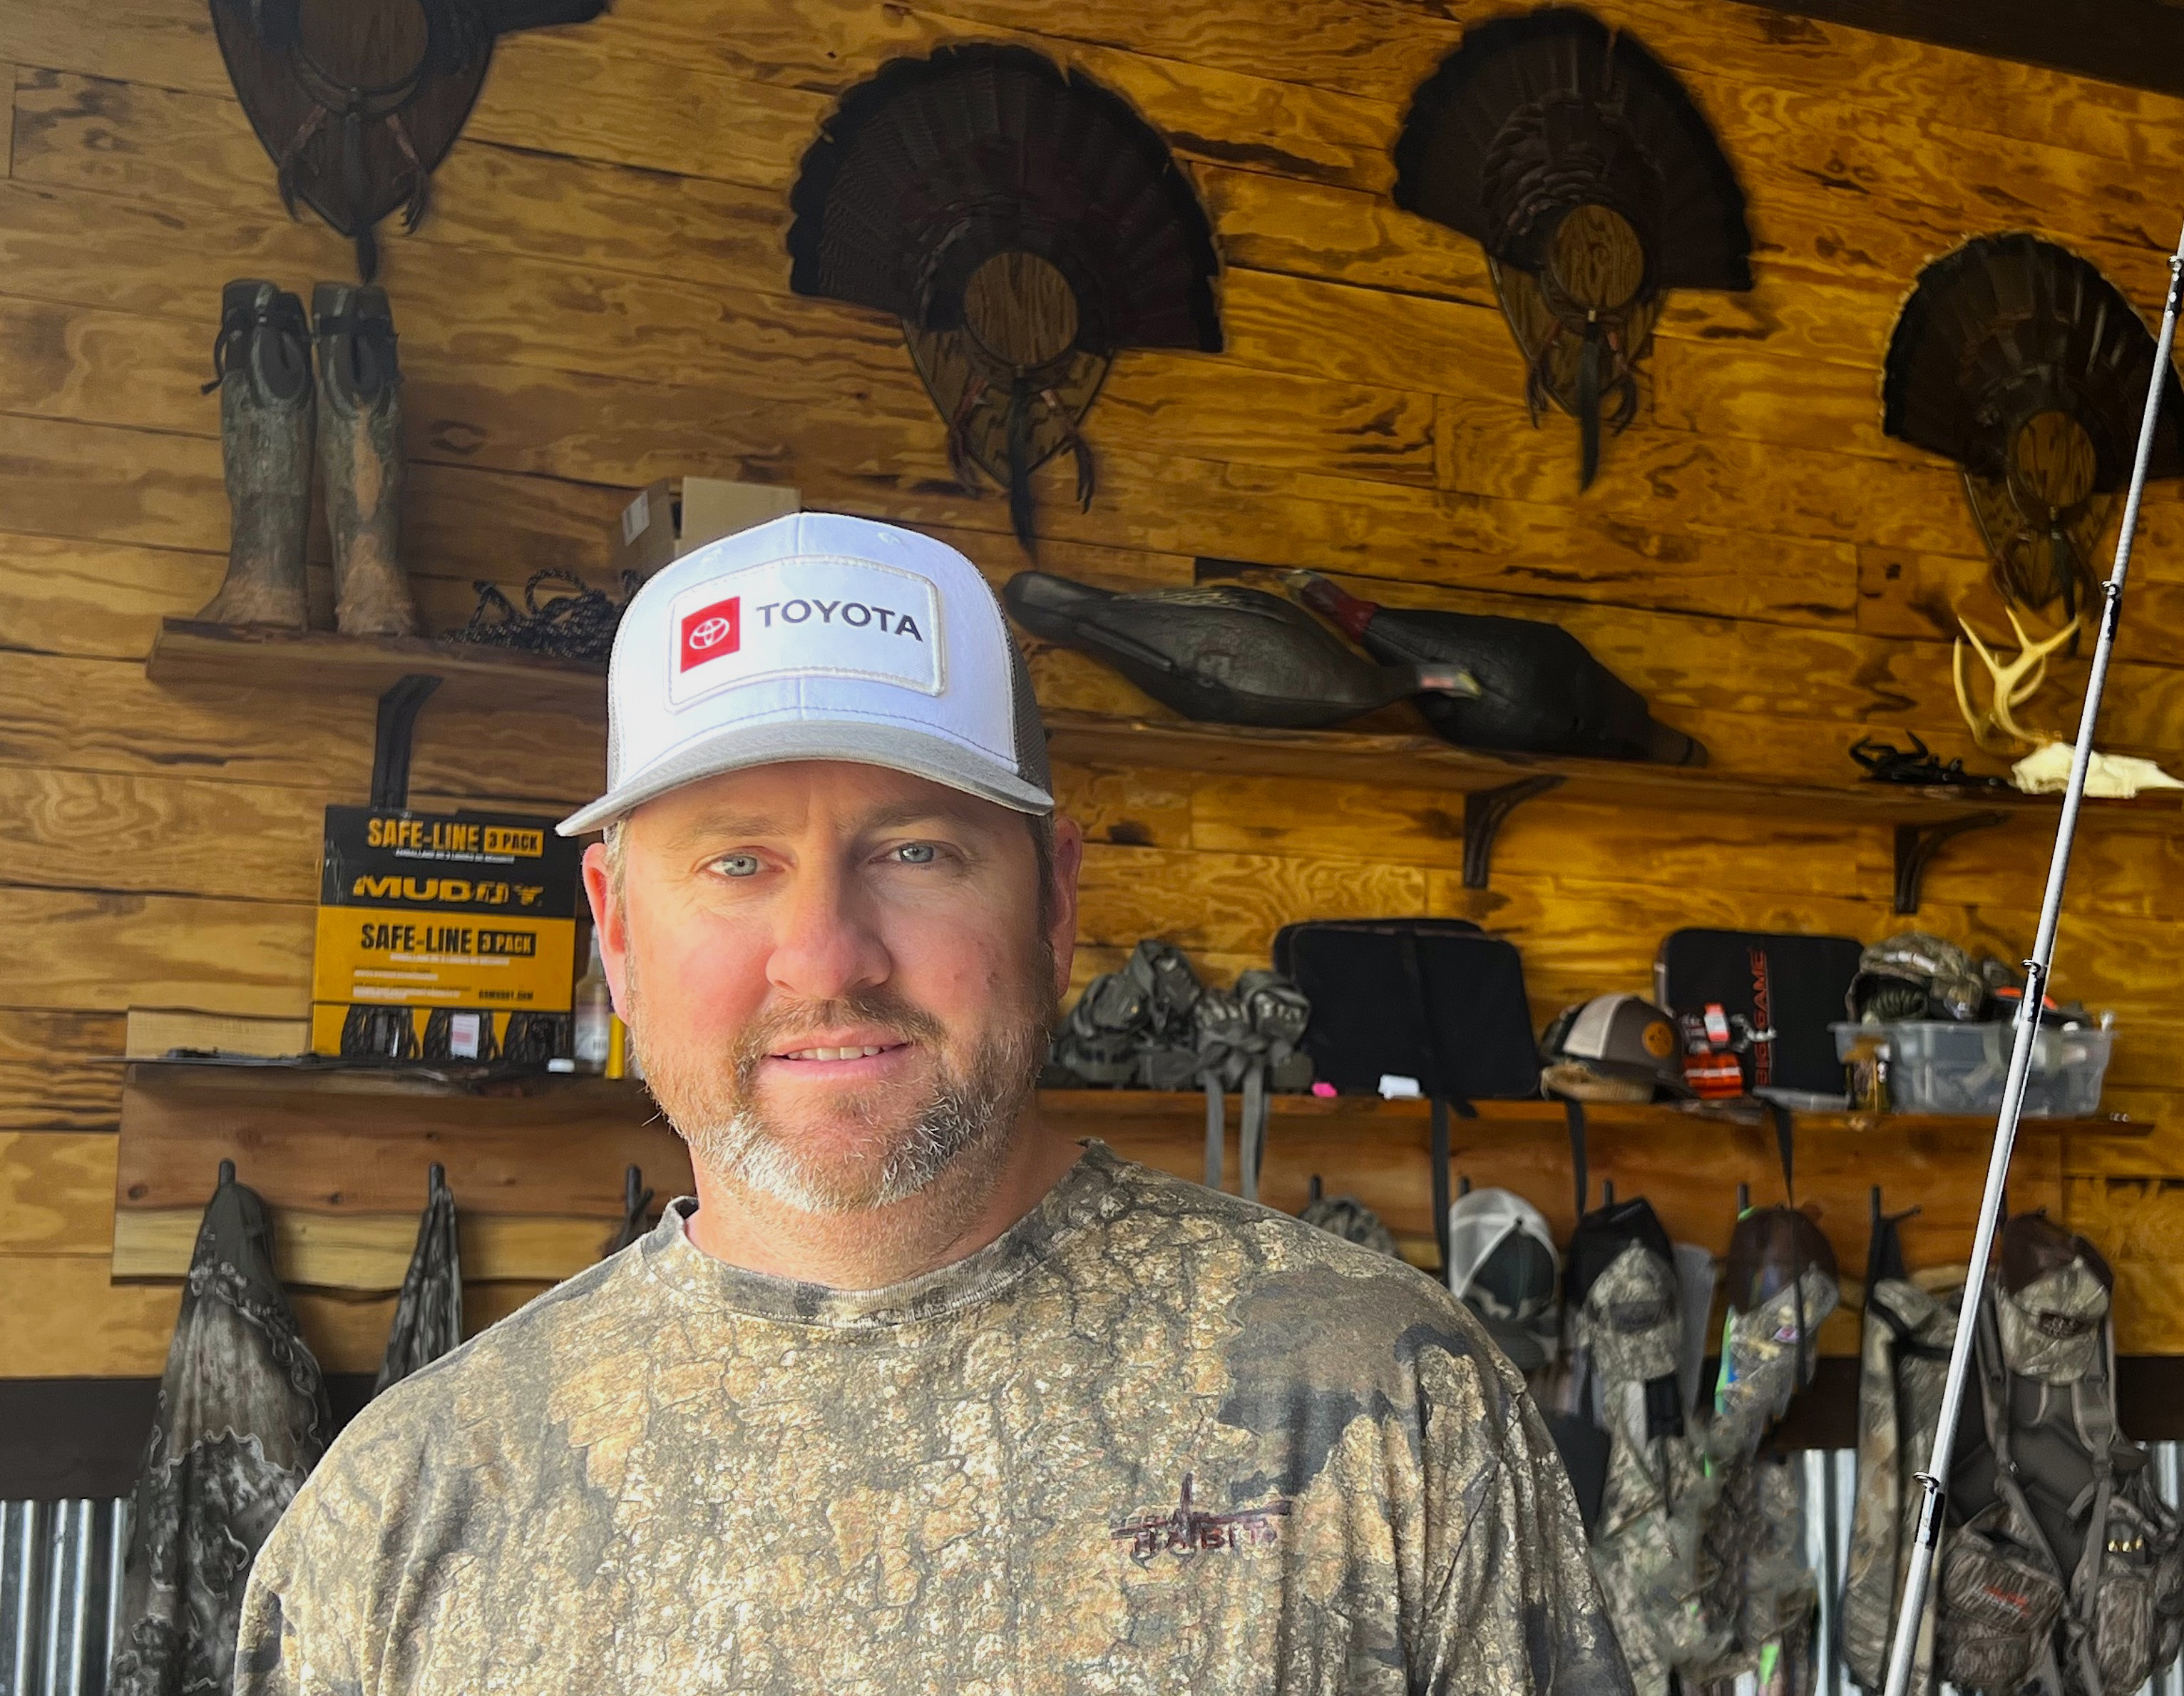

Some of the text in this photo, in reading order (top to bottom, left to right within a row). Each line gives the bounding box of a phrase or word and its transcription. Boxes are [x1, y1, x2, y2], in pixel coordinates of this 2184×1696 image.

[756, 599, 923, 643] TOYOTA
[367, 817, 538, 852] SAFE-LINE 3 PACK
[361, 923, 532, 954] SAFE-LINE 3 PACK
[1750, 951, 1768, 1029] GAME
